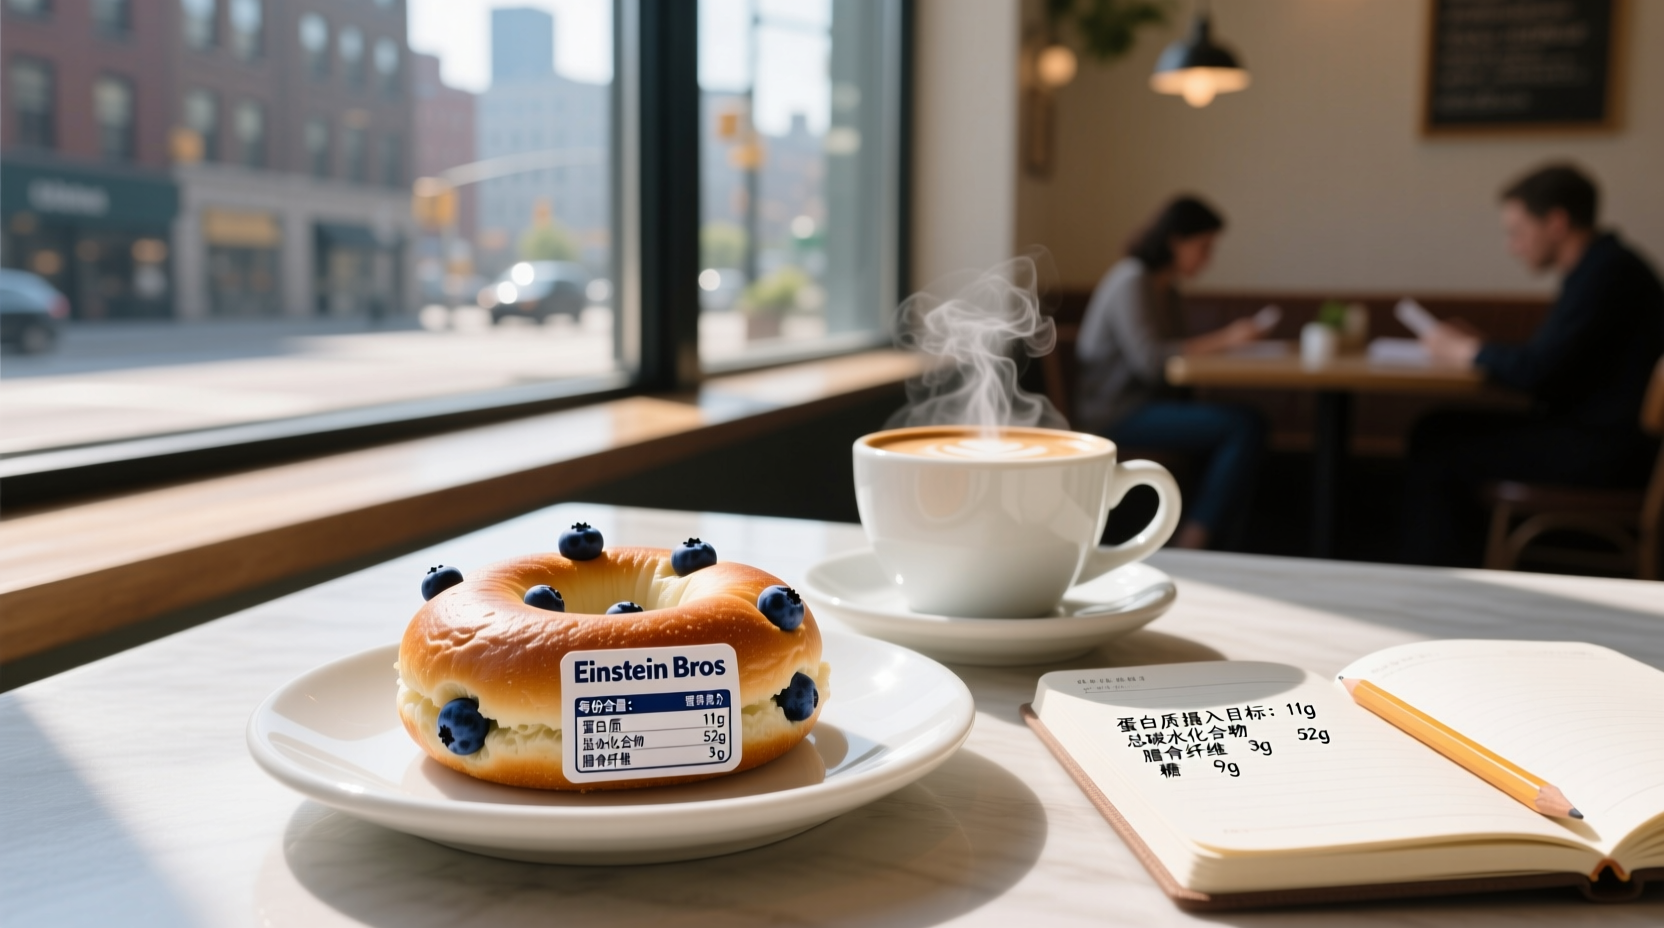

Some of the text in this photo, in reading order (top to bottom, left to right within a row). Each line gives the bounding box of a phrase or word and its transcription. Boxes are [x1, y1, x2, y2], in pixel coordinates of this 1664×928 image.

[574, 656, 726, 683] Einstein Bros
[1286, 702, 1316, 719] 11g
[703, 712, 725, 727] 11g
[703, 730, 726, 745] 52g
[1297, 727, 1330, 744] 52g
[1248, 740, 1273, 756] 3g
[1213, 759, 1240, 777] 9g
